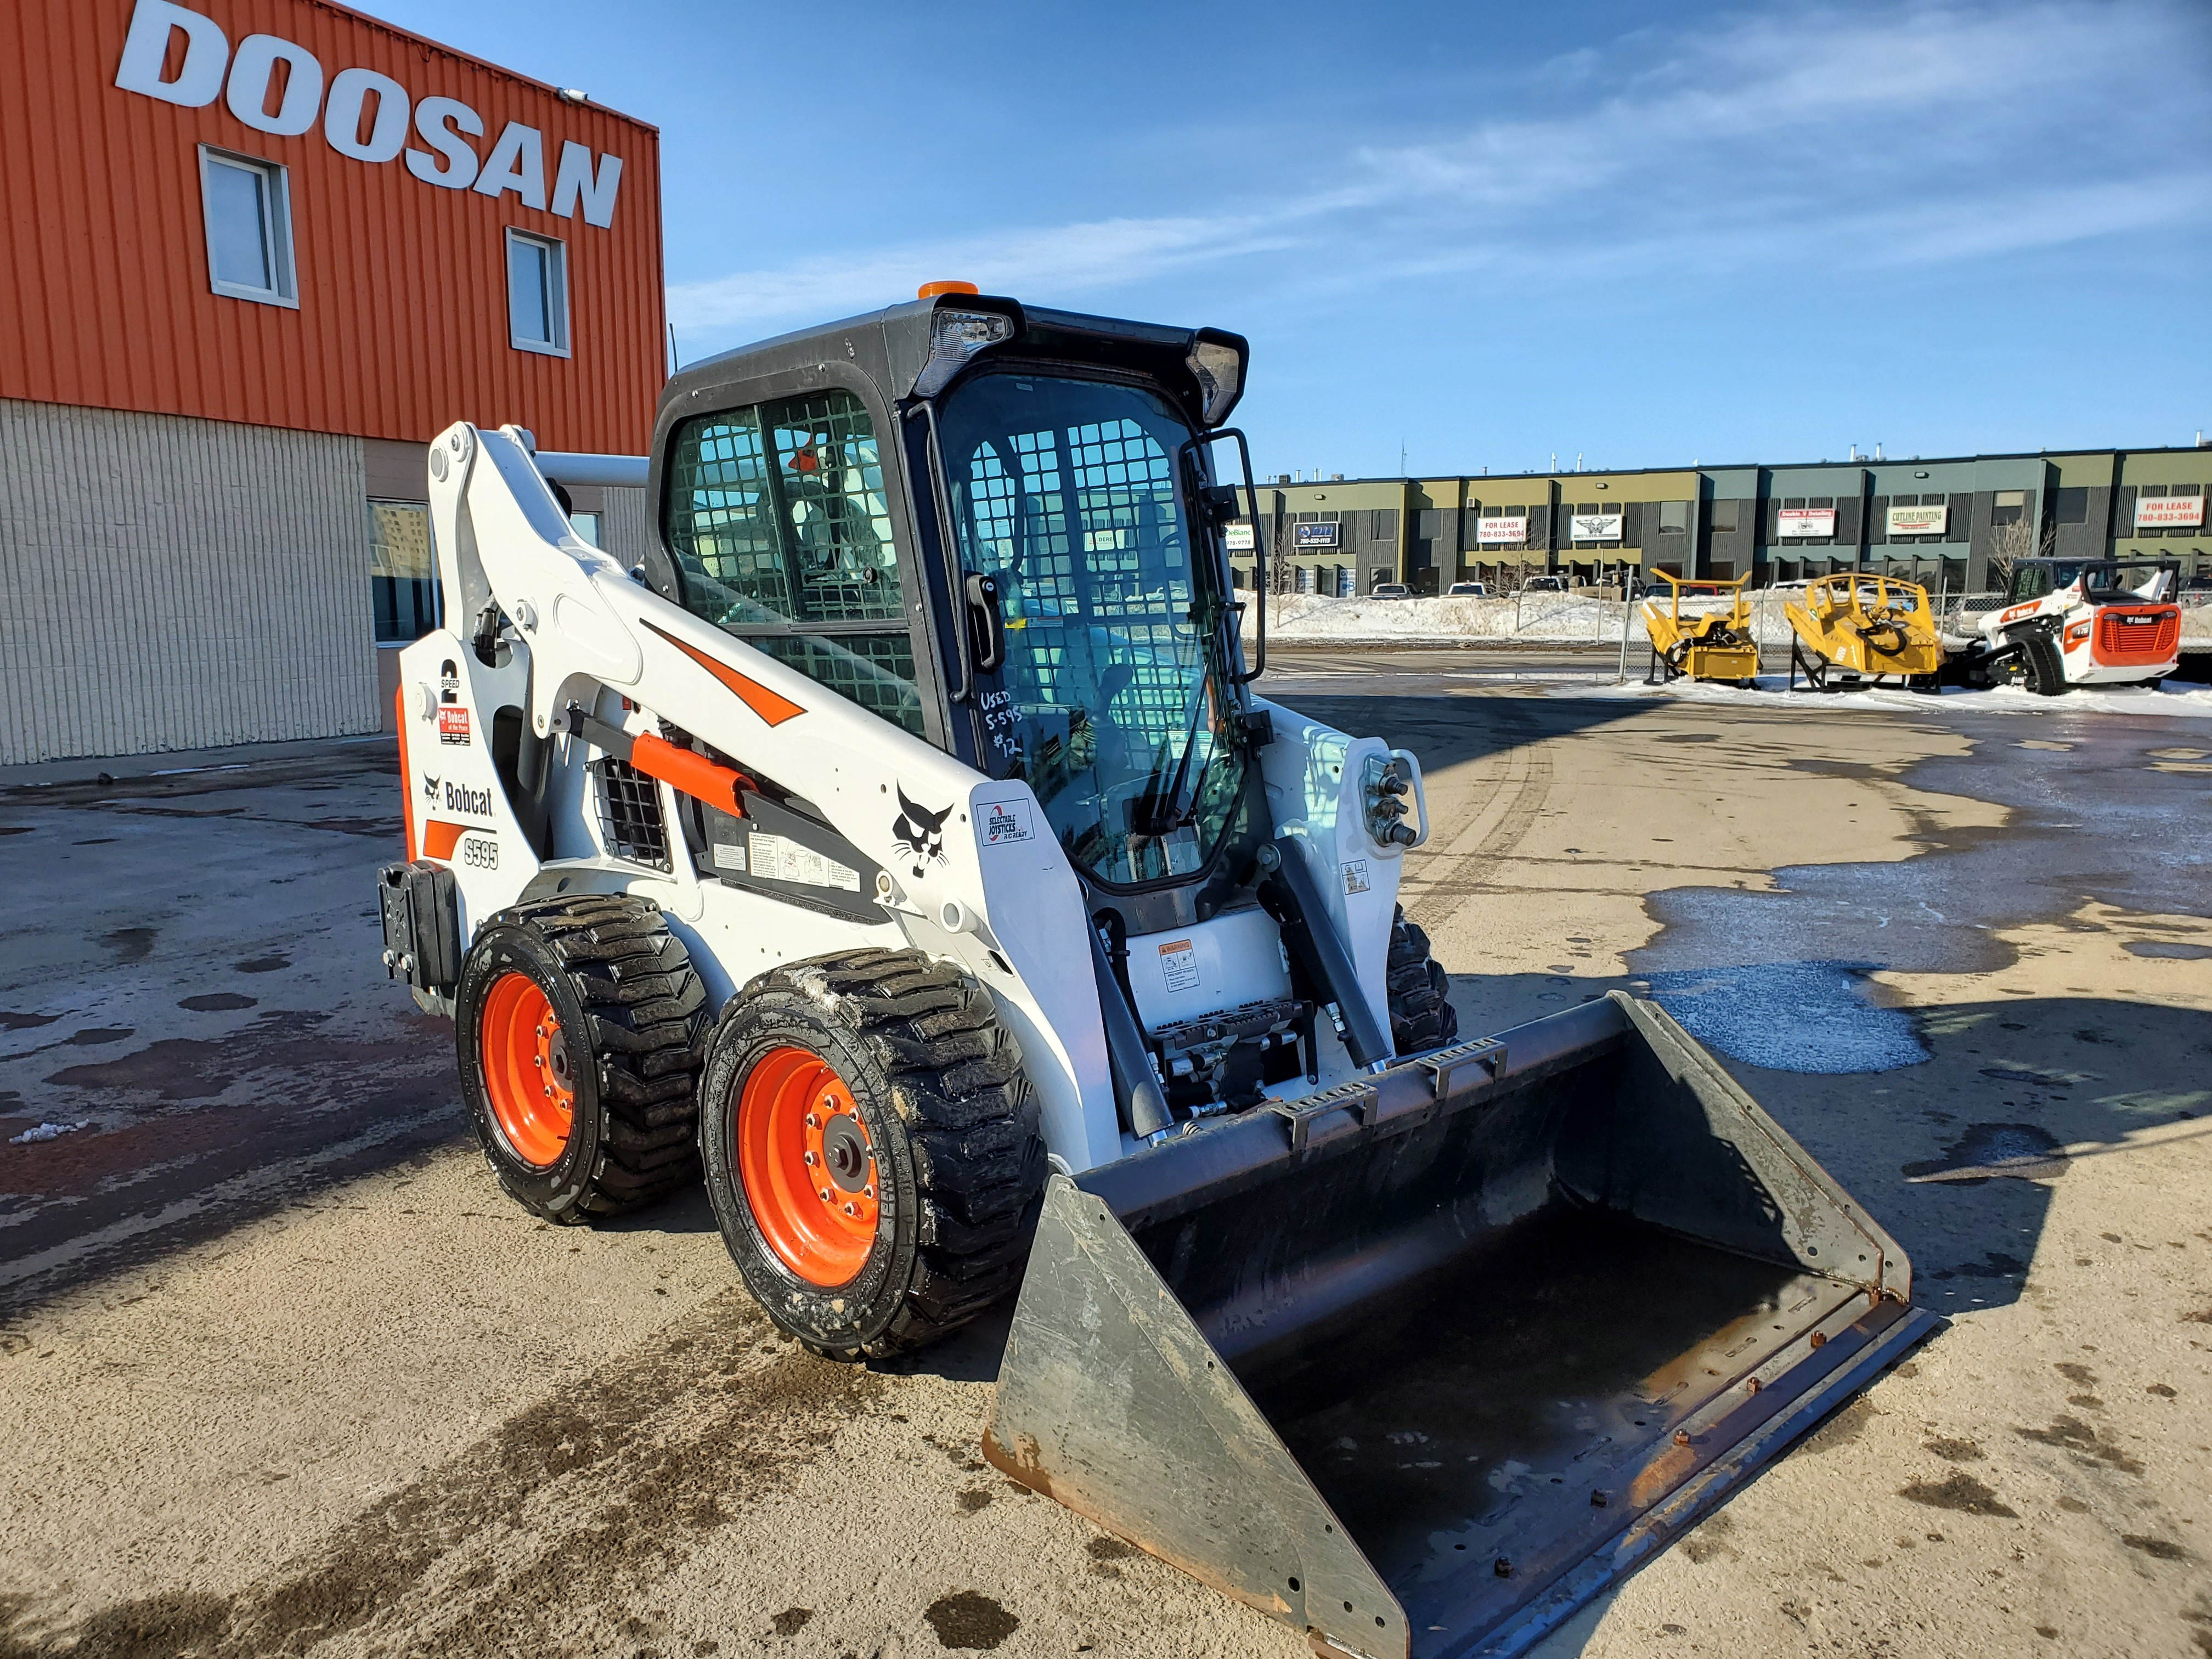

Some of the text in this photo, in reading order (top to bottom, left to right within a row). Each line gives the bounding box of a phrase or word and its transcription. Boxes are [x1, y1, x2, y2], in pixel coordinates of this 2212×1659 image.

[115, 0, 623, 229] DOOSAN
[2166, 502, 2193, 510] LEASE
[1892, 511, 1941, 521] CUTLINE PAINTING
[2137, 513, 2199, 521] 780-833-3694
[2017, 605, 2034, 618] Bobcat
[441, 659, 458, 704] 2
[441, 679, 460, 689] SPEED
[980, 691, 1011, 710] USED
[447, 710, 468, 724] Bobcat
[445, 781, 493, 817] Bobcat
[989, 815, 1015, 825] SELECTABLE
[989, 823, 1016, 836] JOYSTICKS
[464, 838, 498, 870] S595
[1166, 942, 1189, 952] WARNING
